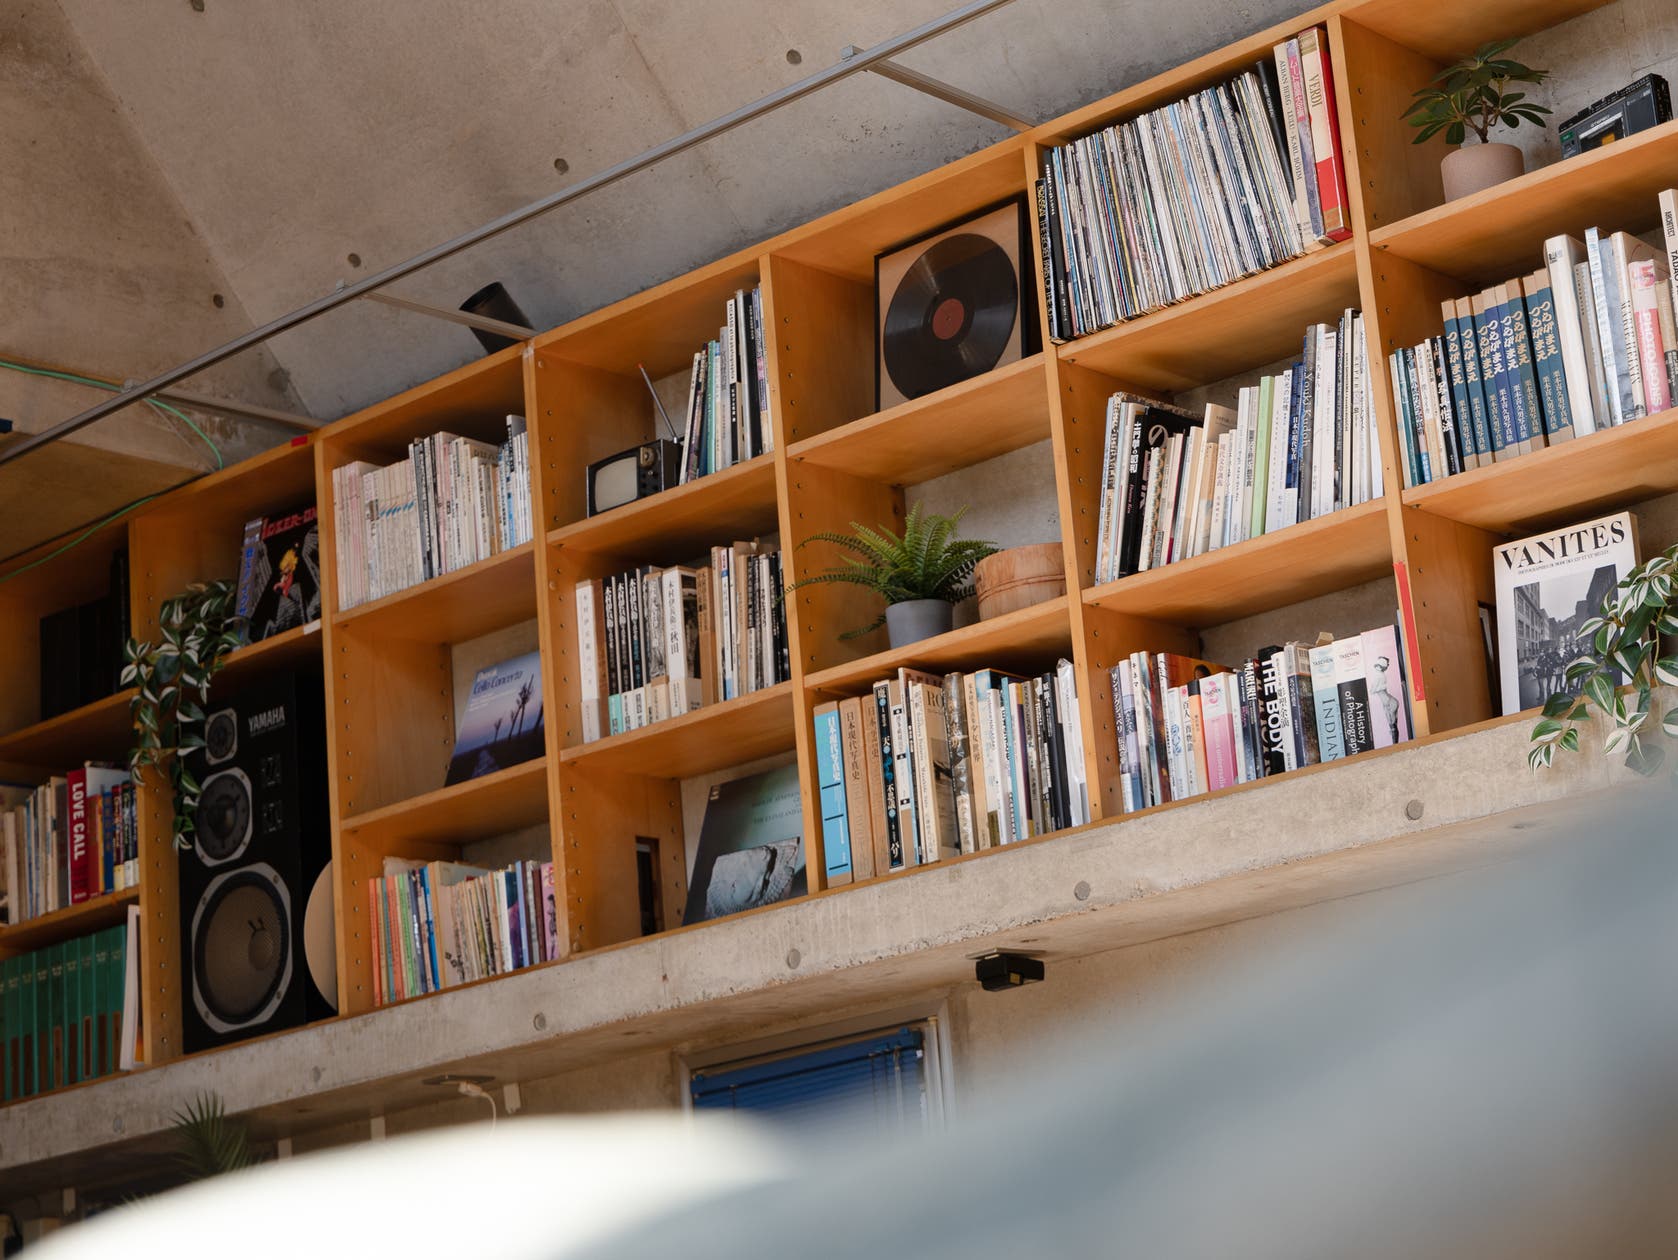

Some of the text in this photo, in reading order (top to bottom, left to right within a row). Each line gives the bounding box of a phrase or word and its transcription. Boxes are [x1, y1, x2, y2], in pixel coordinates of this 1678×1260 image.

[1306, 74, 1325, 108] VERDI
[1262, 660, 1278, 703] THE
[1344, 691, 1352, 700] of
[248, 706, 285, 732] YAMAHA
[1266, 704, 1286, 754] BODY
[1355, 710, 1366, 745] History
[72, 782, 85, 861] LOVE CALL
